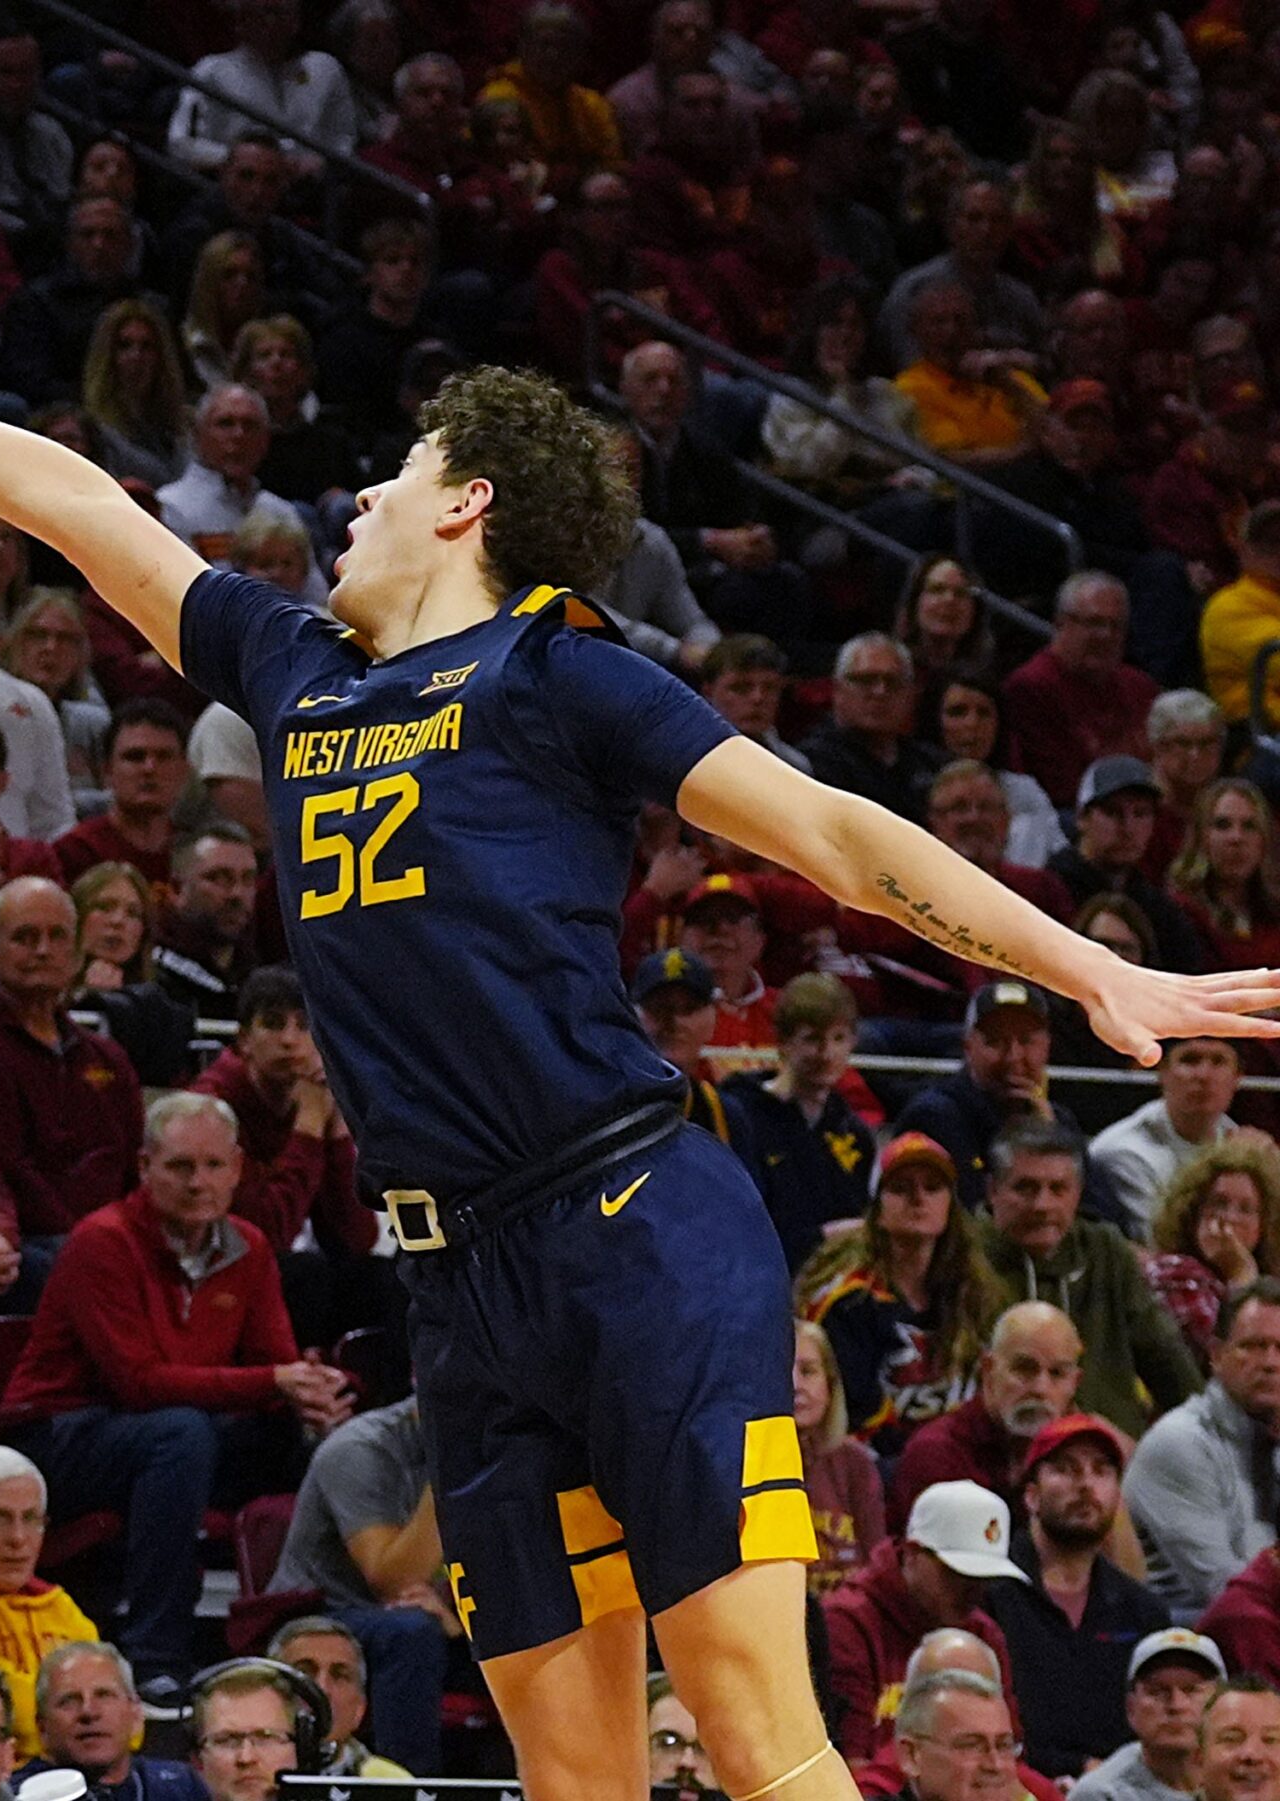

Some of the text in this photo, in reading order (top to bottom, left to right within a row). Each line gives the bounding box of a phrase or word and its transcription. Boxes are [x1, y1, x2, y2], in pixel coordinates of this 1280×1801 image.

[283, 702, 463, 780] WEST VIRGINIA
[300, 771, 426, 920] 52
